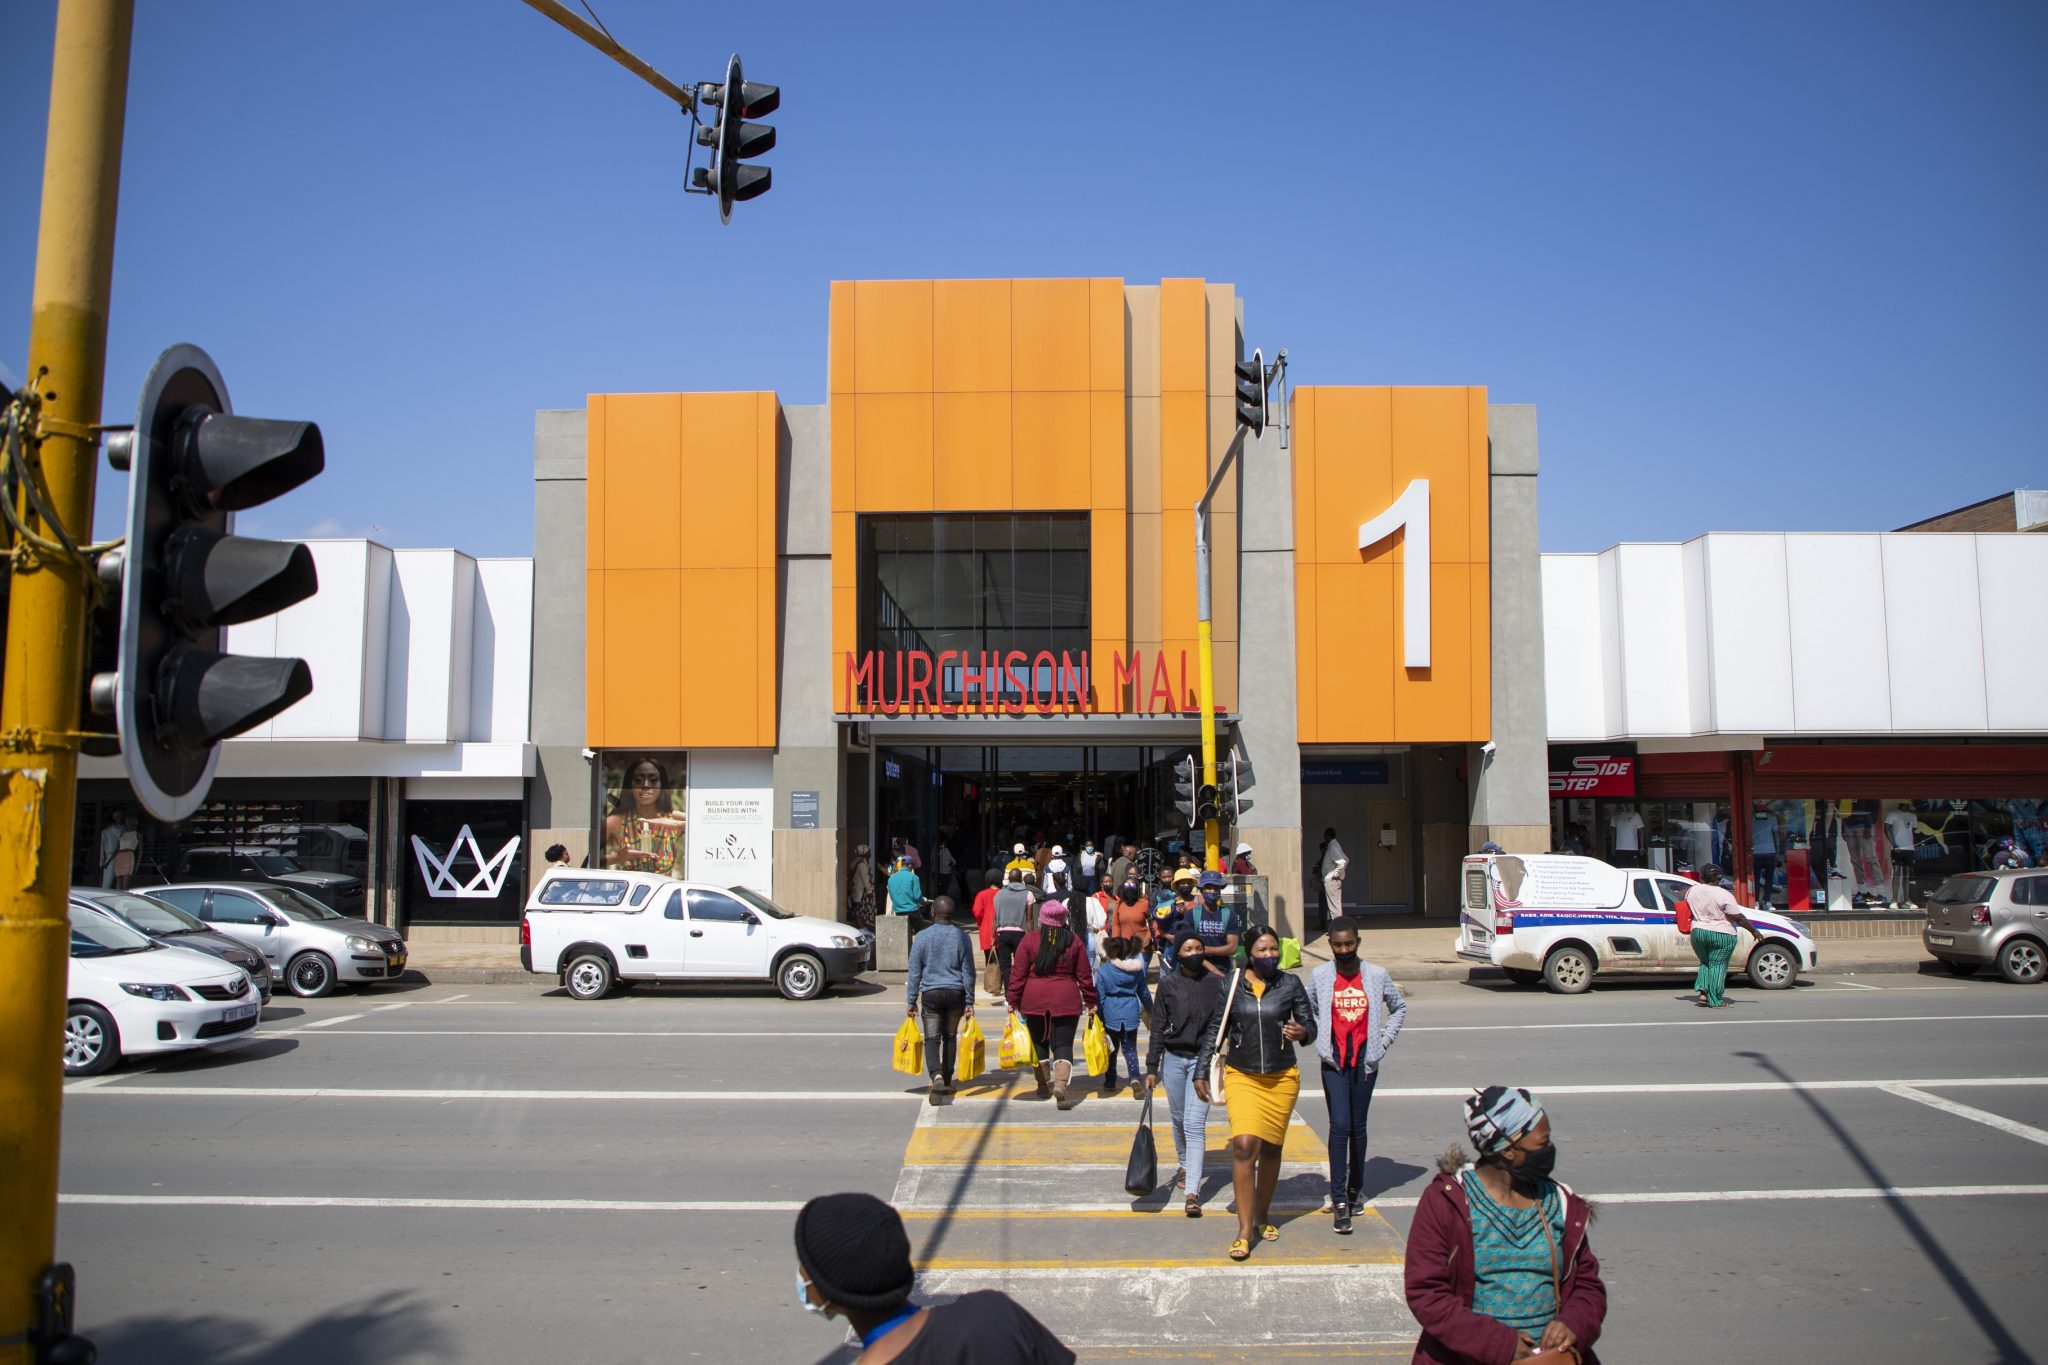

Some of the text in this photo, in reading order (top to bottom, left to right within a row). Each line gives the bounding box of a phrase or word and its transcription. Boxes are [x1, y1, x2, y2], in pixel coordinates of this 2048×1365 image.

[1359, 479, 1430, 667] 1
[845, 649, 1227, 713] MURCHISON MAL
[1570, 755, 1631, 776] SIDE
[704, 847, 758, 860] SENZA
[1334, 997, 1368, 1008] HERO
